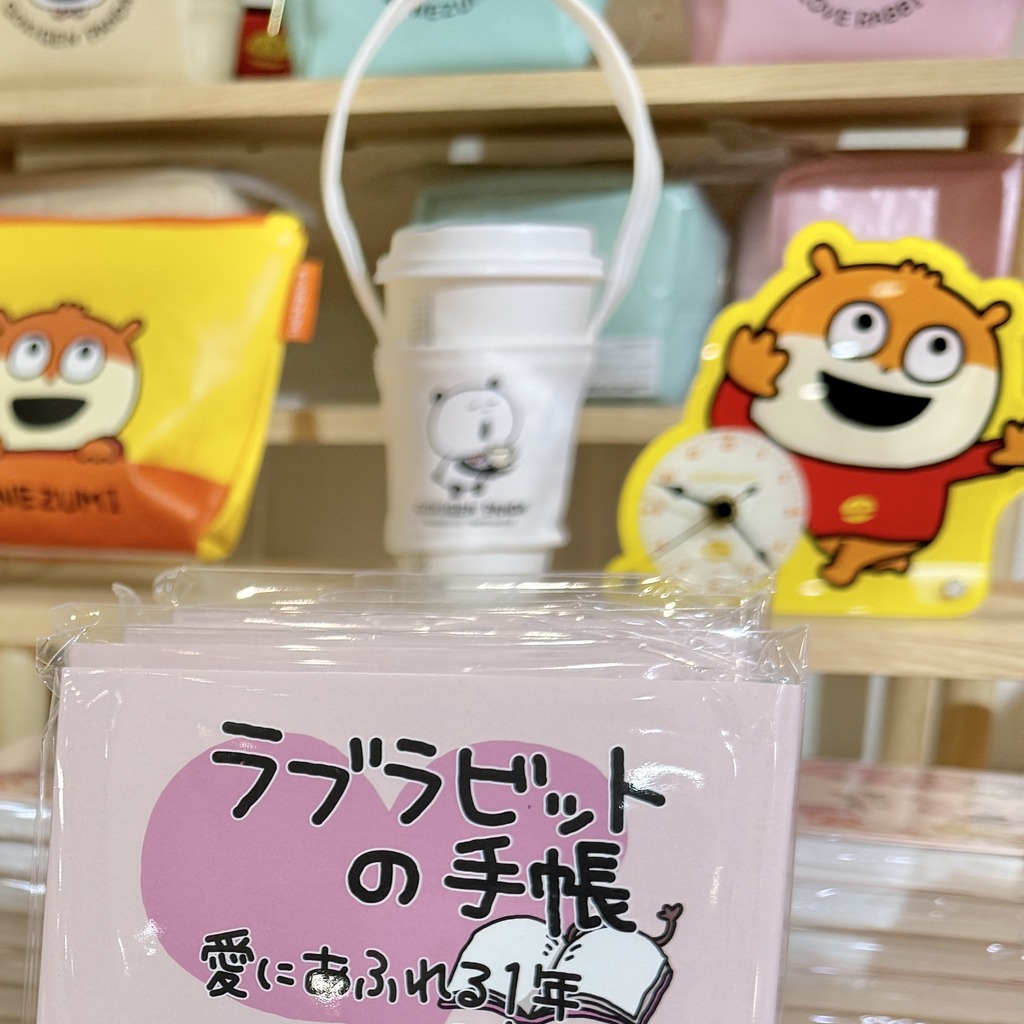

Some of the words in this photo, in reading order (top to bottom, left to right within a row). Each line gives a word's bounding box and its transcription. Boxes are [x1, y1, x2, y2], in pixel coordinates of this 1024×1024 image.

[803, 0, 851, 28] OVE
[853, 0, 924, 29] RABB
[211, 720, 667, 834] ラブラビット
[347, 836, 637, 938] の手帳
[200, 928, 582, 1021] 愛にあふれる1年
